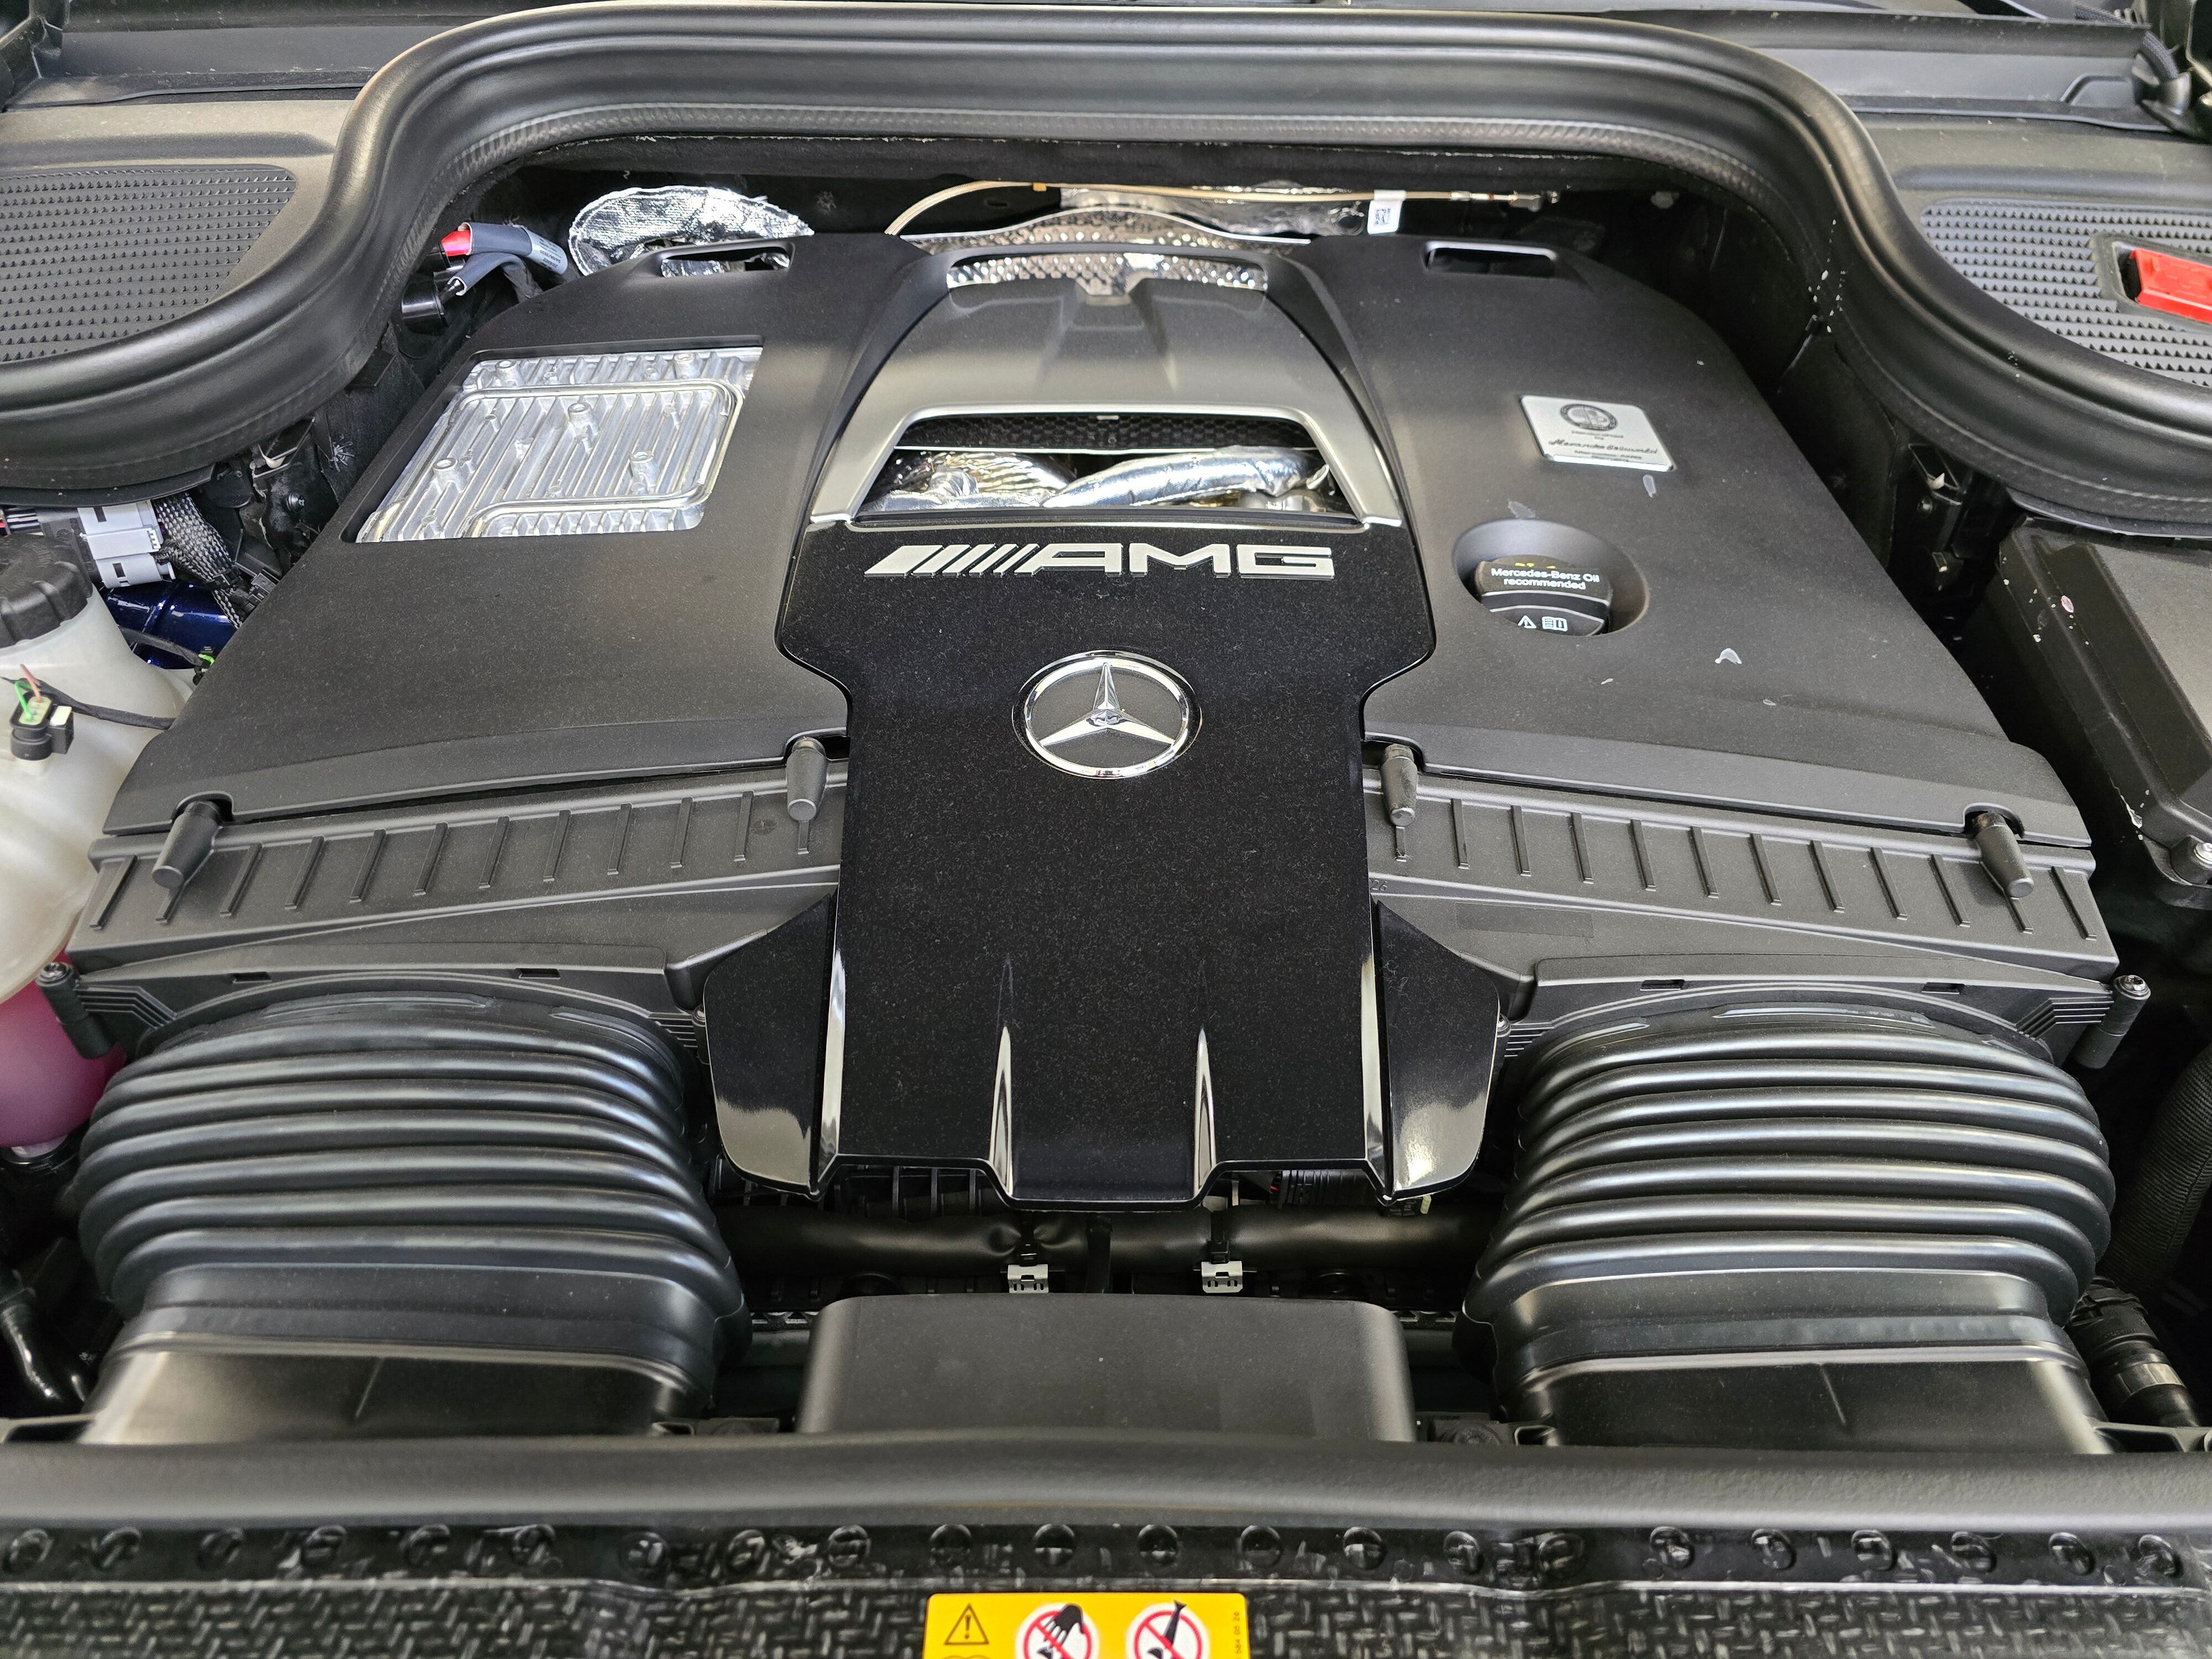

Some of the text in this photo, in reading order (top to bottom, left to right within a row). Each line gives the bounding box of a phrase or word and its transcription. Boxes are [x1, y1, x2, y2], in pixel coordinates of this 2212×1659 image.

[1015, 543, 1335, 579] AMG
[1491, 568, 1600, 583] Mercedes-Benz Oil
[1504, 578, 1586, 590] recommended
